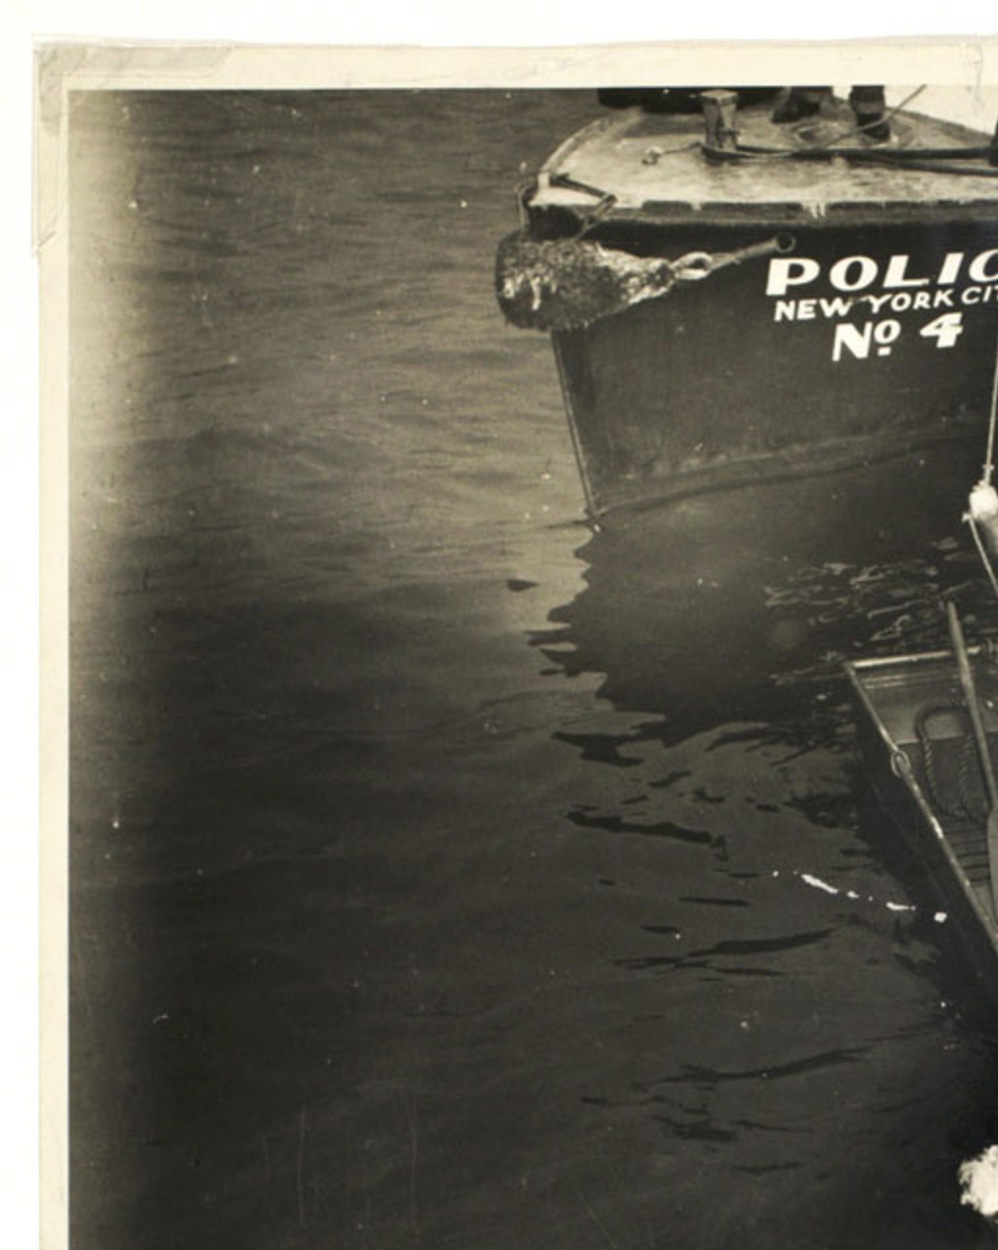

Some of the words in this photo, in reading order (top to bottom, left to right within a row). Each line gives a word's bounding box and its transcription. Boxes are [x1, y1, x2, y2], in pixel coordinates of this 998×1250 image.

[774, 296, 853, 322] NEW
[855, 288, 954, 314] YORK
[919, 311, 964, 348] 4
